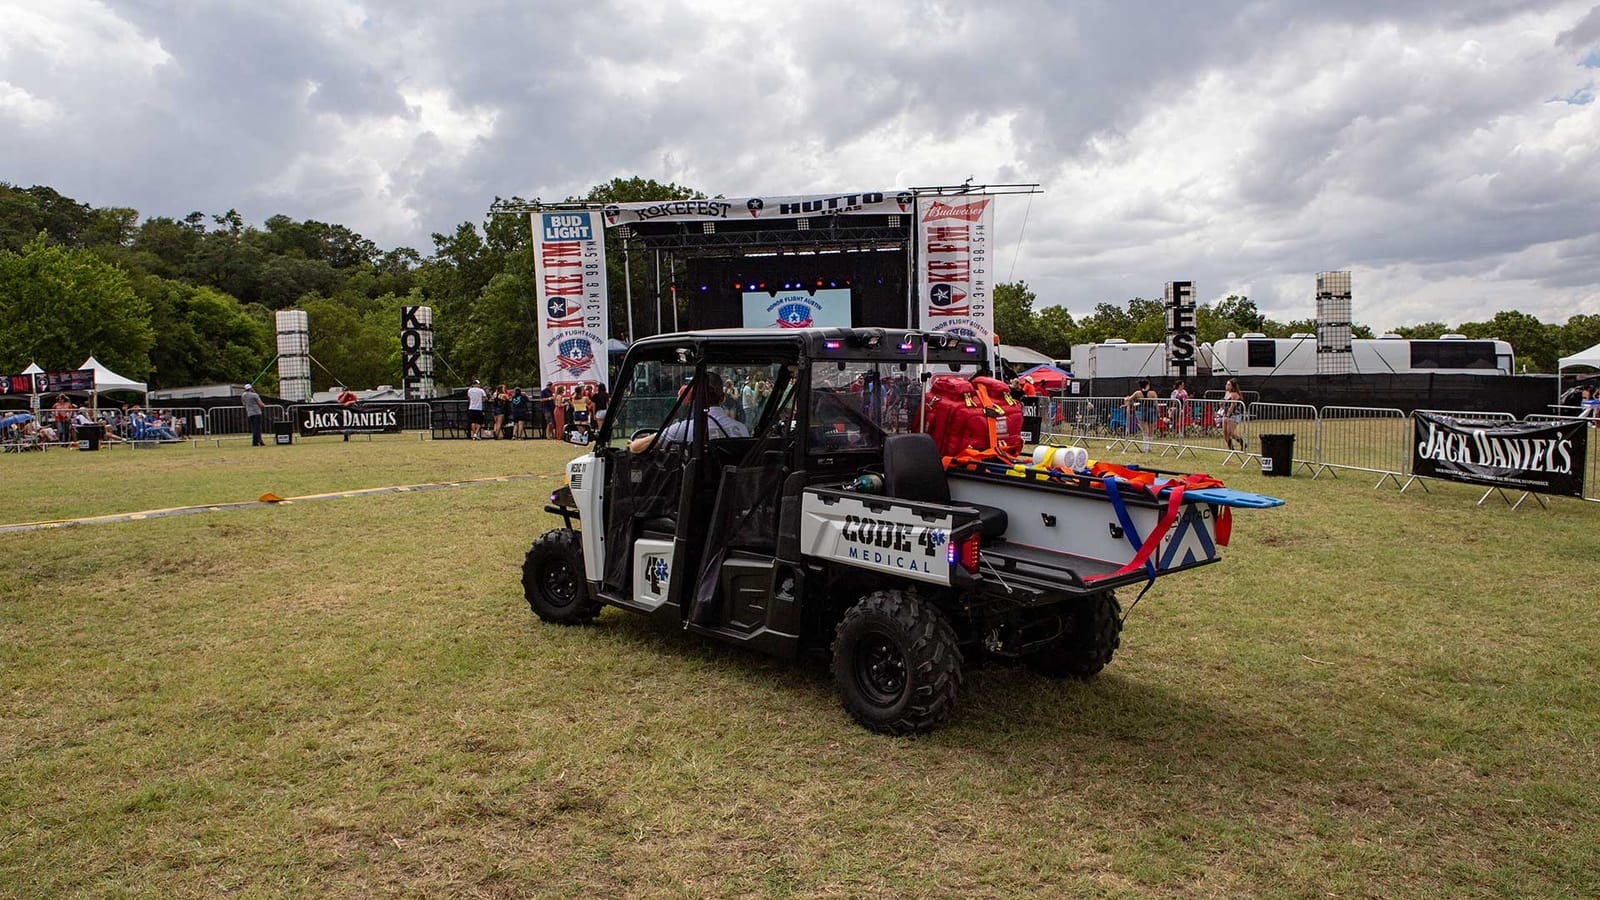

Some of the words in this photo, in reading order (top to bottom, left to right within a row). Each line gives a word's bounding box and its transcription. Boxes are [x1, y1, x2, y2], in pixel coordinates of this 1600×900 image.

[634, 201, 731, 220] KOKEFEST
[780, 193, 883, 214] HUTTO
[821, 205, 862, 215] TEXAS
[928, 206, 982, 217] Budweiser
[551, 215, 582, 227] BUD
[546, 226, 589, 239] LIGHT
[767, 299, 783, 312] HONOR
[804, 297, 823, 311] AUSTIN
[932, 320, 948, 331] ONOR
[970, 320, 989, 335] AUSTIN
[1171, 281, 1195, 376] FEST
[585, 331, 604, 345] AUSTIN
[401, 306, 421, 400] KOKE
[304, 410, 339, 429] JACK
[342, 409, 397, 427] DANIEL'S
[1418, 422, 1471, 465] JACK
[1473, 431, 1573, 474] DANIEL'S
[842, 515, 914, 552] CODE
[918, 527, 936, 556] 4
[849, 547, 931, 573] MEDICAL
